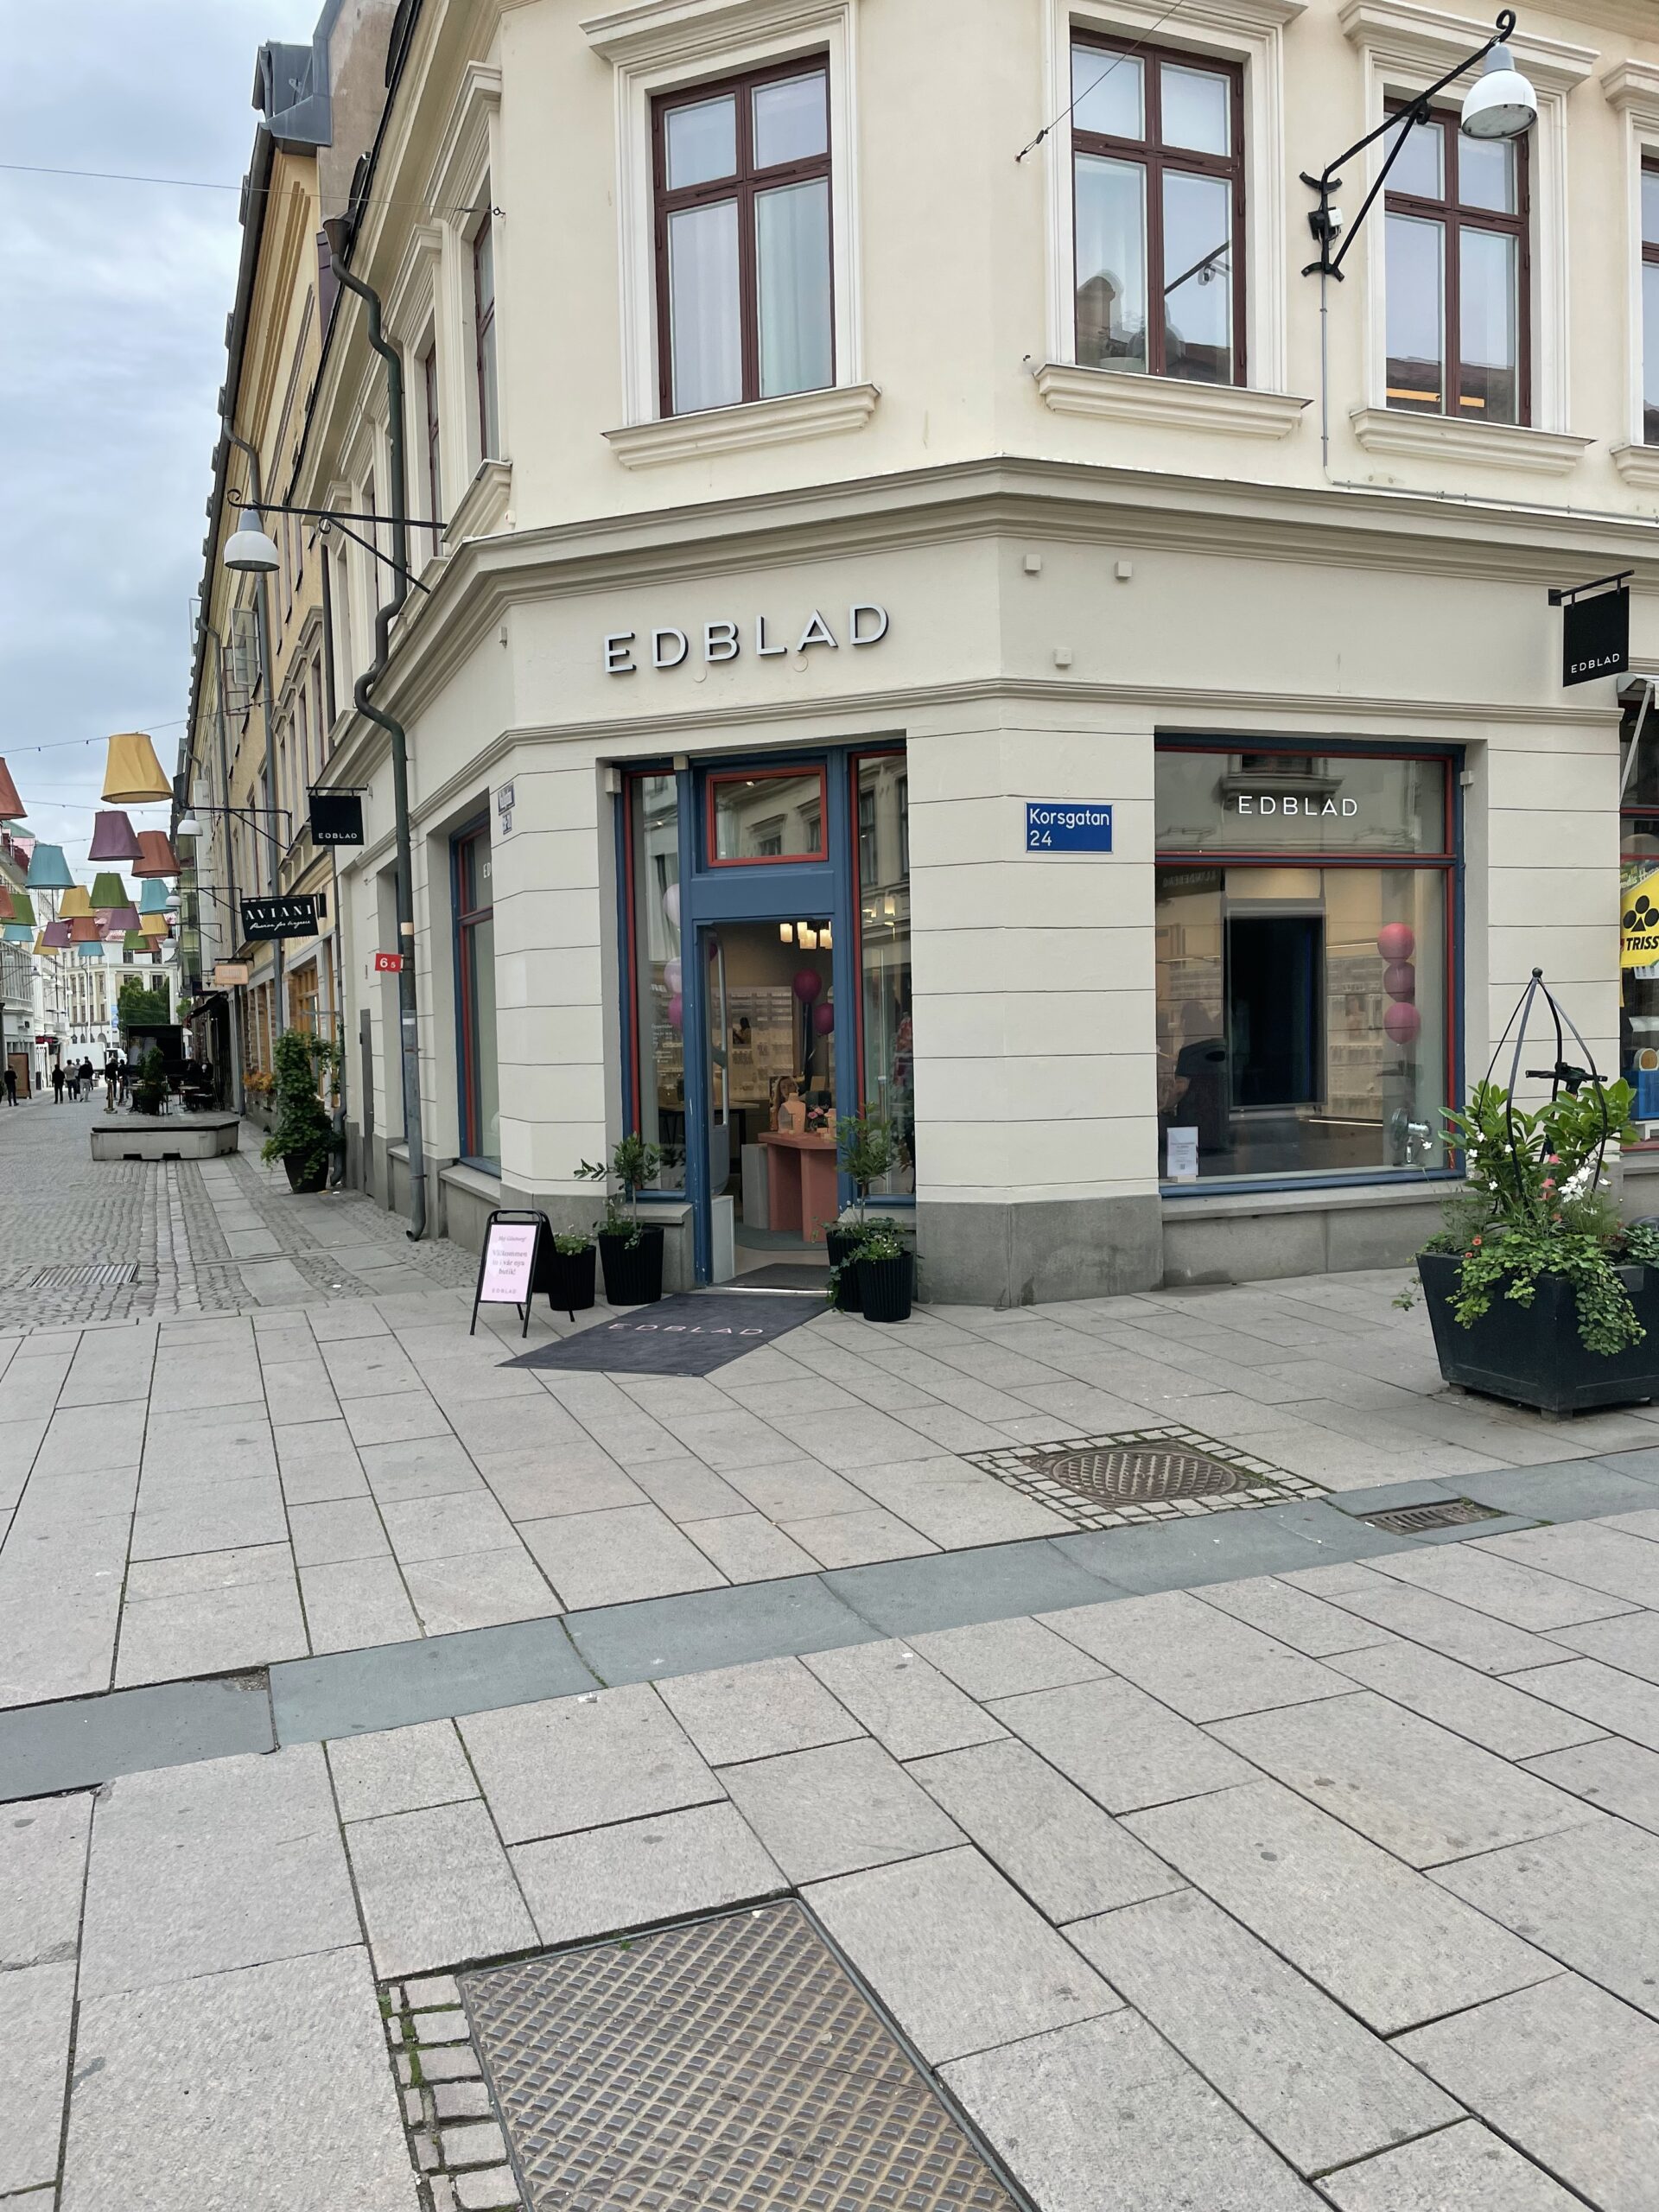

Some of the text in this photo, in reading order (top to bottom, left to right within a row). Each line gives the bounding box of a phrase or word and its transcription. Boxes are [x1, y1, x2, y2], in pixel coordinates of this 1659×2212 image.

[605, 602, 889, 674] EDBLAD
[1571, 653, 1620, 673] EDBLAD
[1238, 795, 1357, 817] EDBLAD
[1029, 808, 1109, 829] Korsgatan
[1029, 830, 1052, 847] 24
[245, 905, 312, 920] AVIANI
[1626, 936, 1659, 951] TRISS
[380, 957, 388, 968] 6
[607, 1323, 764, 1335] EDBLAD
